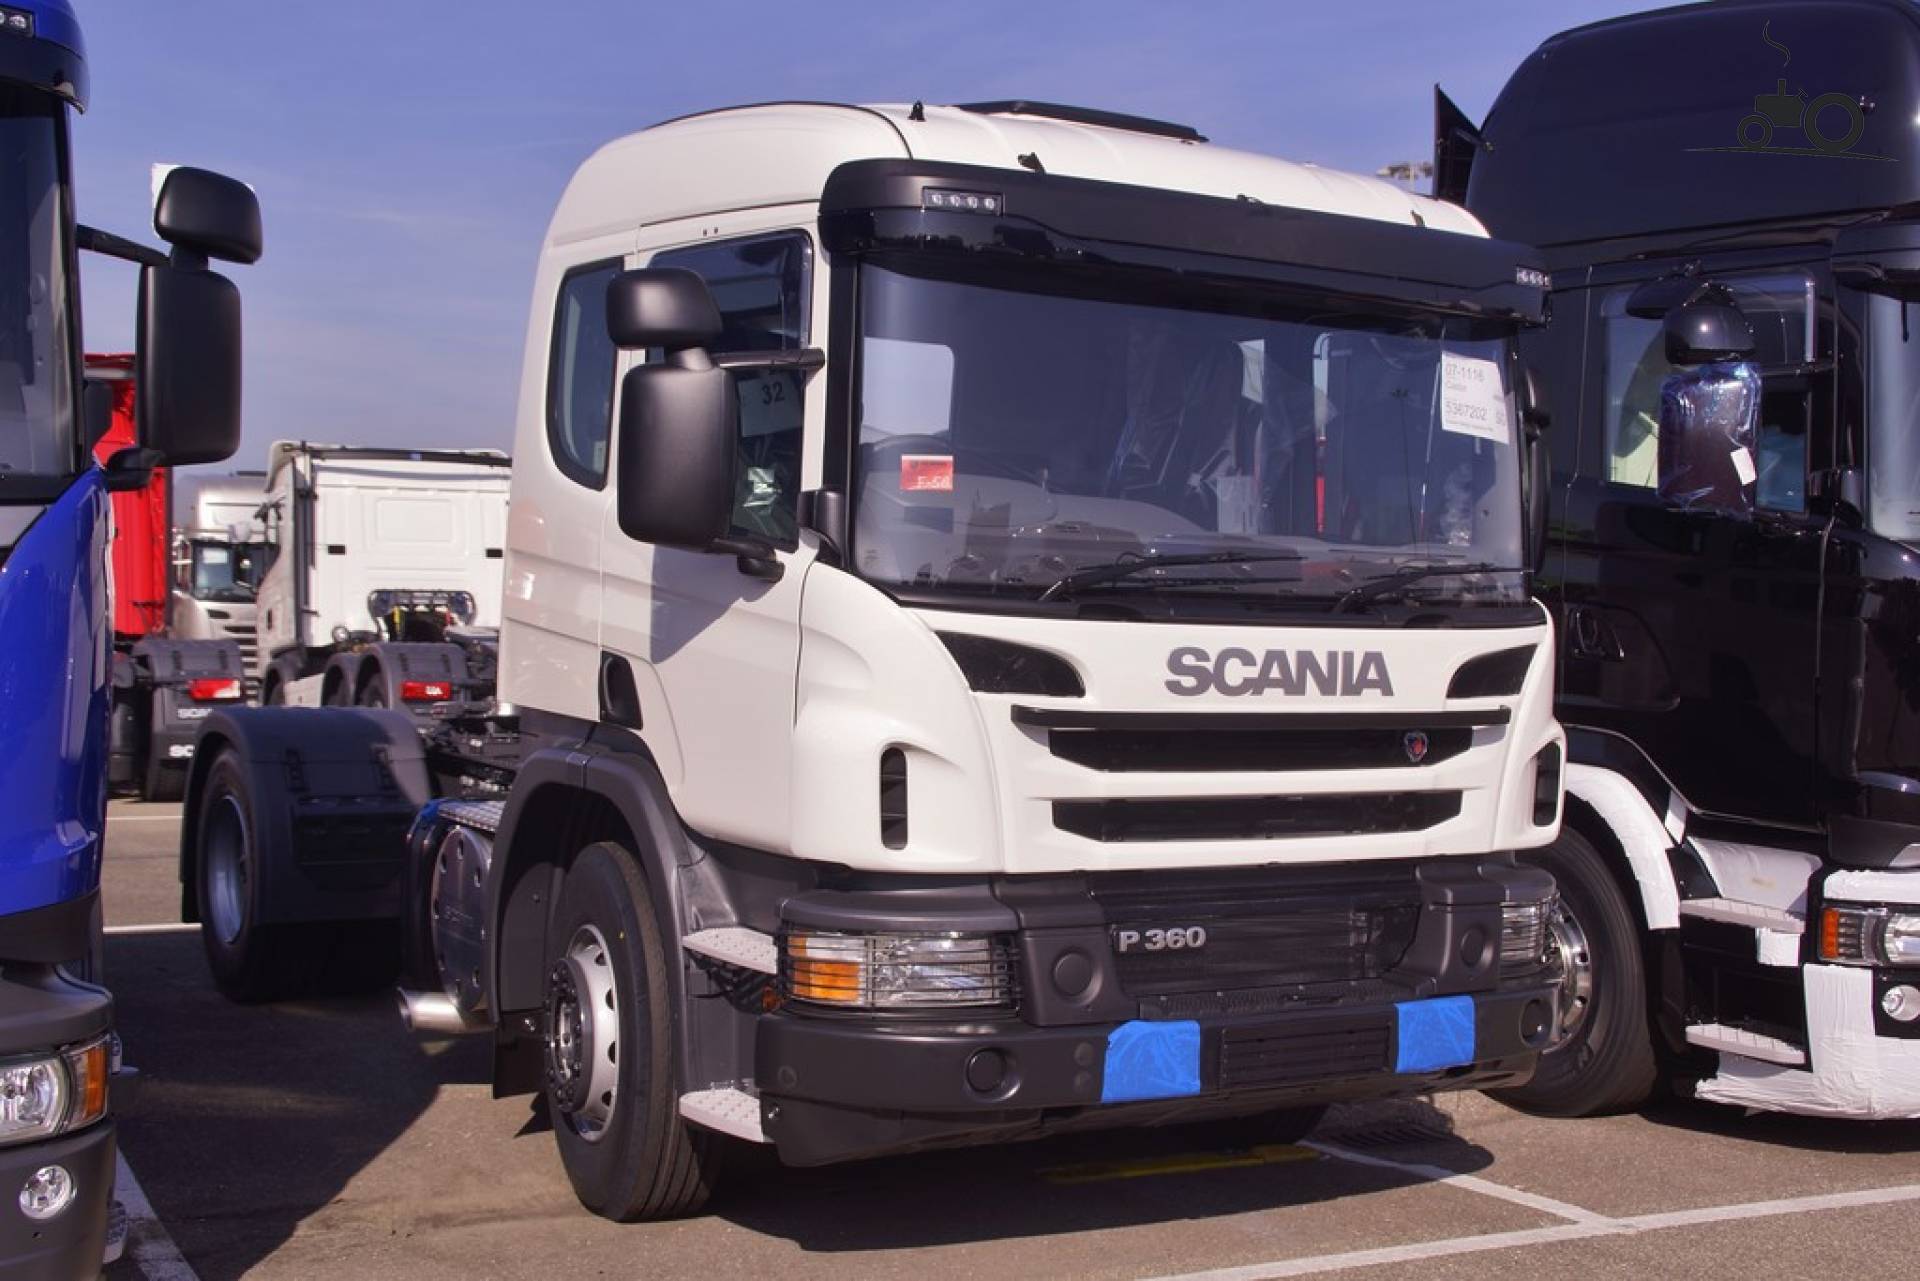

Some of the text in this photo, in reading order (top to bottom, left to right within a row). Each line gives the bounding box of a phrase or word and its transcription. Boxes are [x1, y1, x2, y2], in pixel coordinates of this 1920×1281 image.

[761, 381, 785, 405] 32
[1164, 646, 1394, 697] SCANIA
[1119, 926, 1206, 953] P 360
